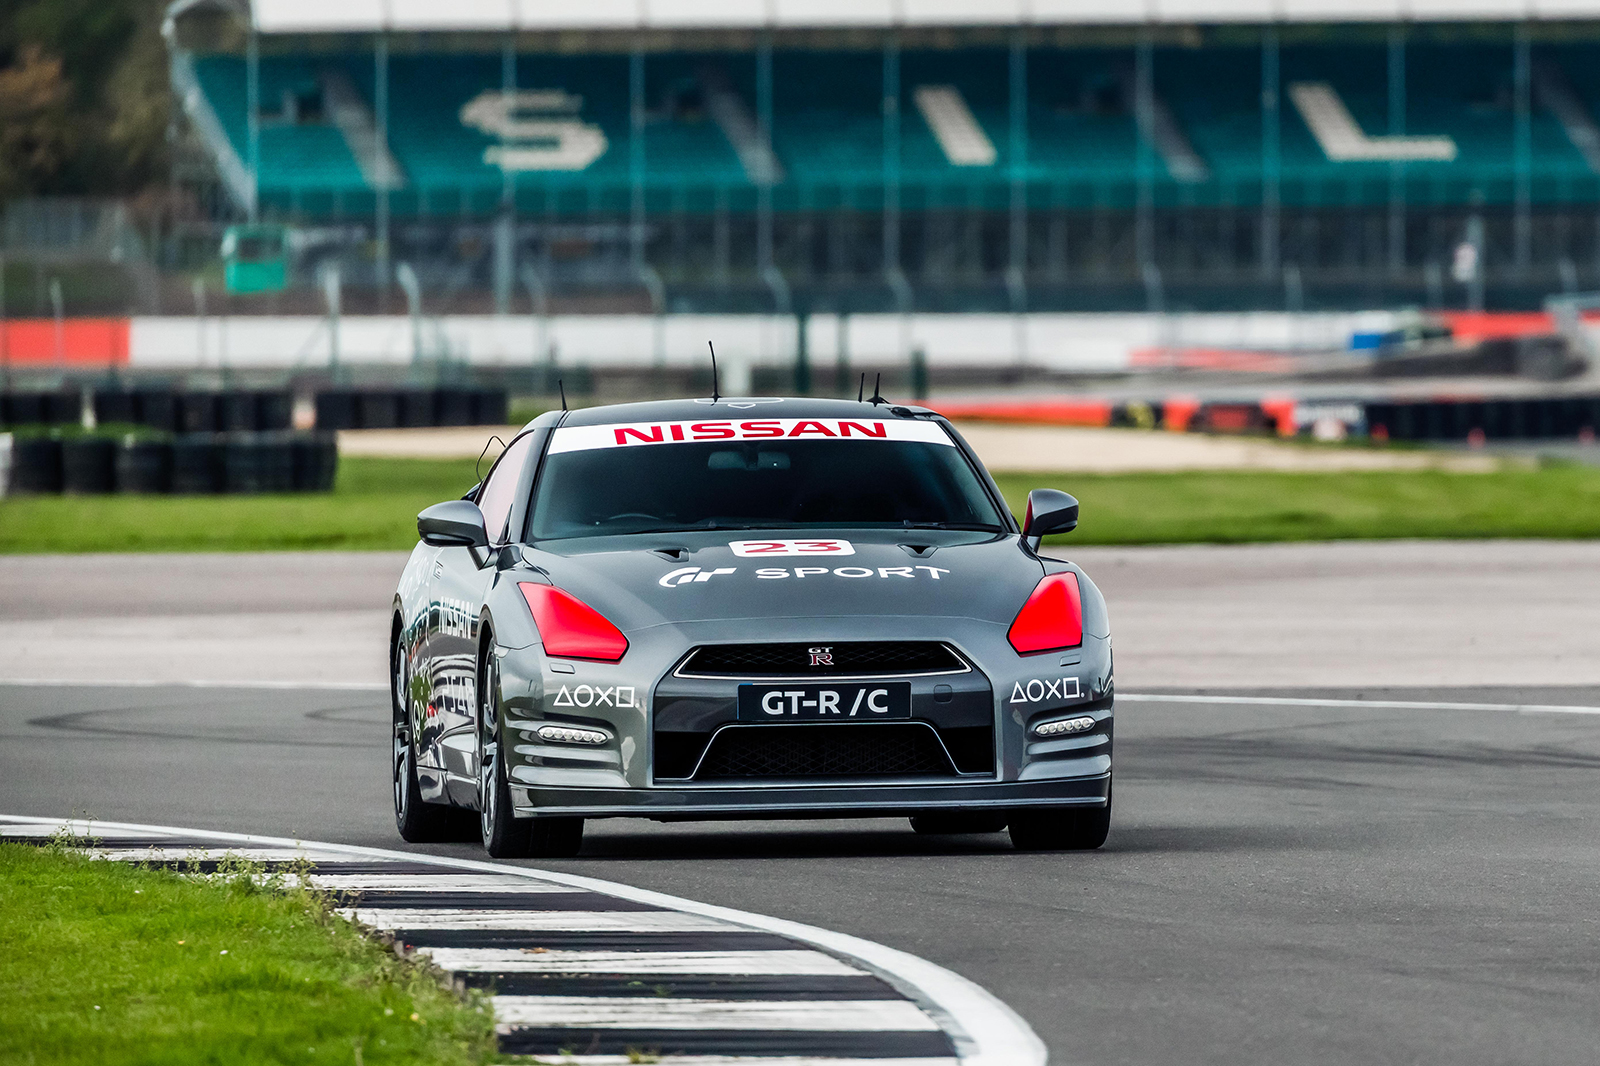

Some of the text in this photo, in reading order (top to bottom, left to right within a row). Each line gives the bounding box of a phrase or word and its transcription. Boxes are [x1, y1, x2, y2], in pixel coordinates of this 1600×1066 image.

[613, 420, 887, 445] NISSAN
[743, 541, 842, 554] 23
[755, 565, 951, 580] SPORT
[438, 596, 474, 640] NISSAN
[761, 688, 888, 717] GT-R /C
